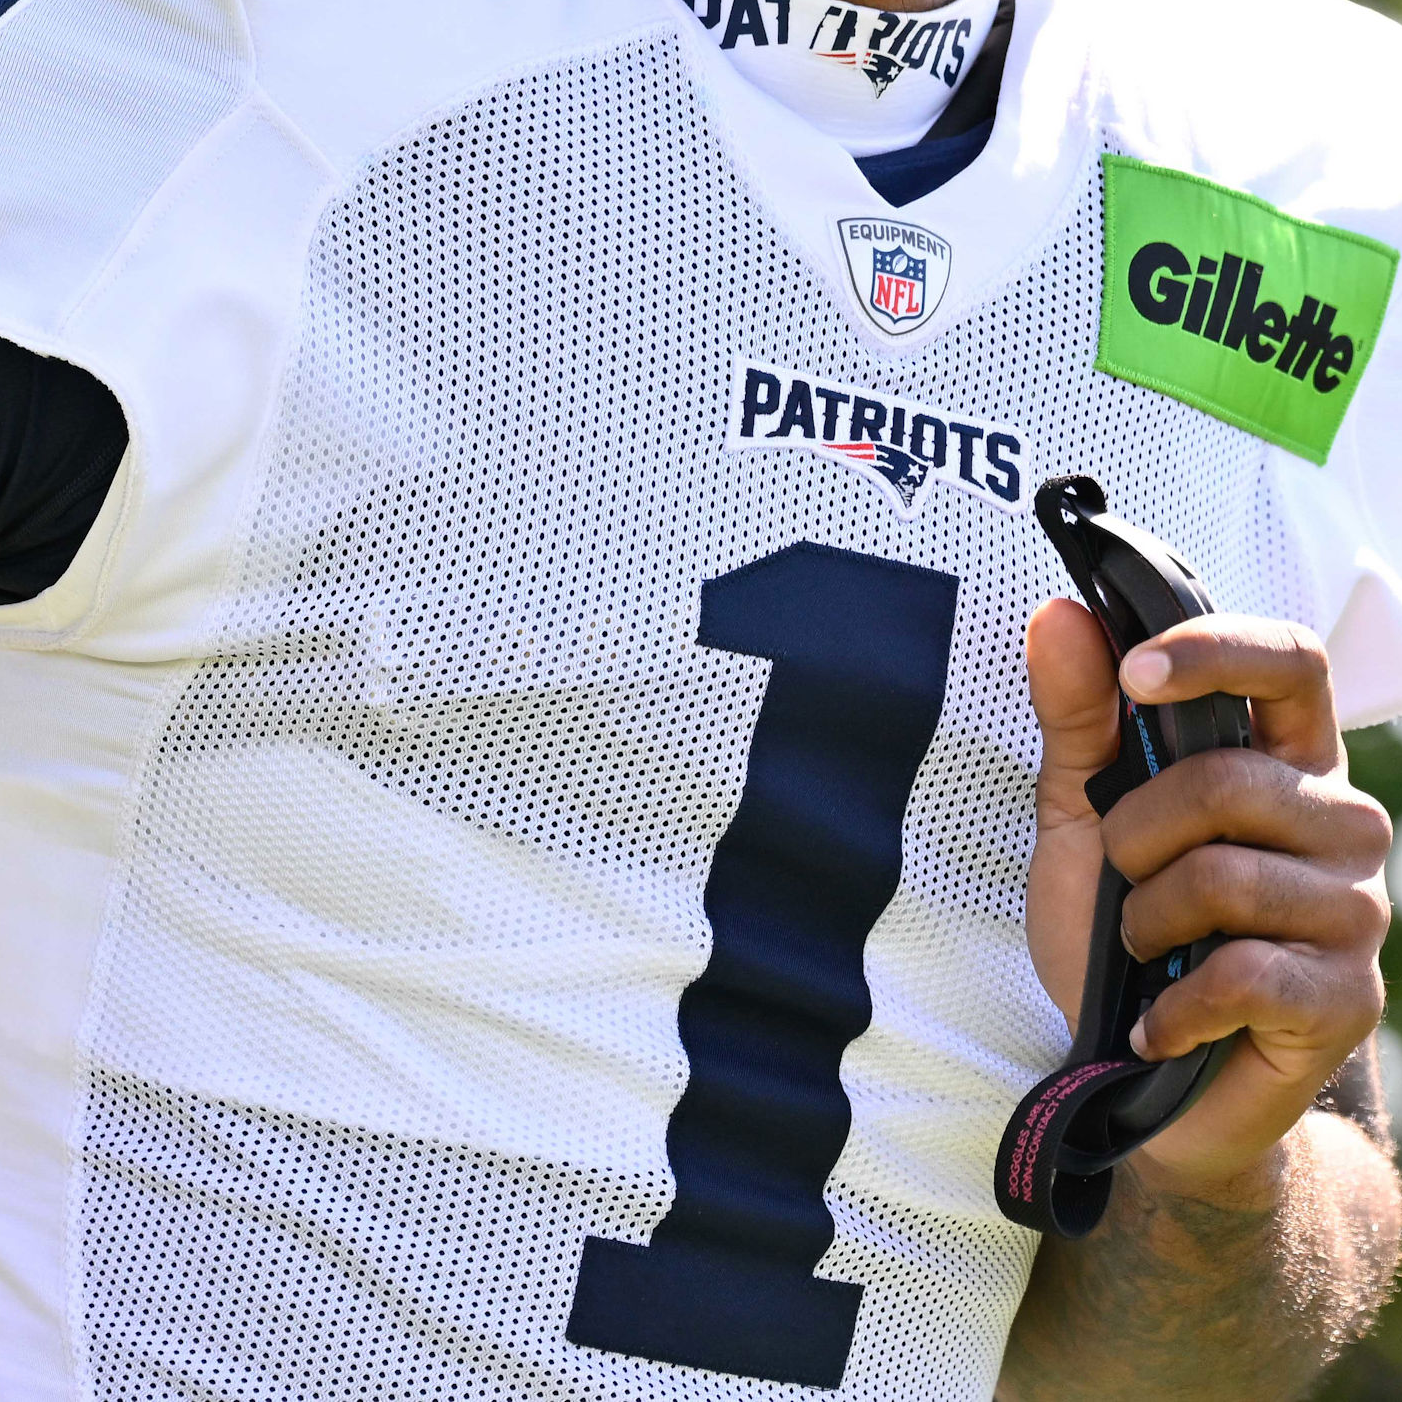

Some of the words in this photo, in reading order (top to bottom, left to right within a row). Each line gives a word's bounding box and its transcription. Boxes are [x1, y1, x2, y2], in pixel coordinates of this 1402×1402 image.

[848, 223, 946, 261] EQUIPMENT
[874, 274, 920, 316] NFL
[1128, 241, 1354, 394] Gillette
[740, 367, 1022, 502] PATRIOTS
[565, 540, 960, 1390] 1
[1008, 1129, 1030, 1198] GOGGLES
[1025, 1102, 1046, 1128] ARE
[1021, 1099, 1059, 1203] NON-CONTACT
